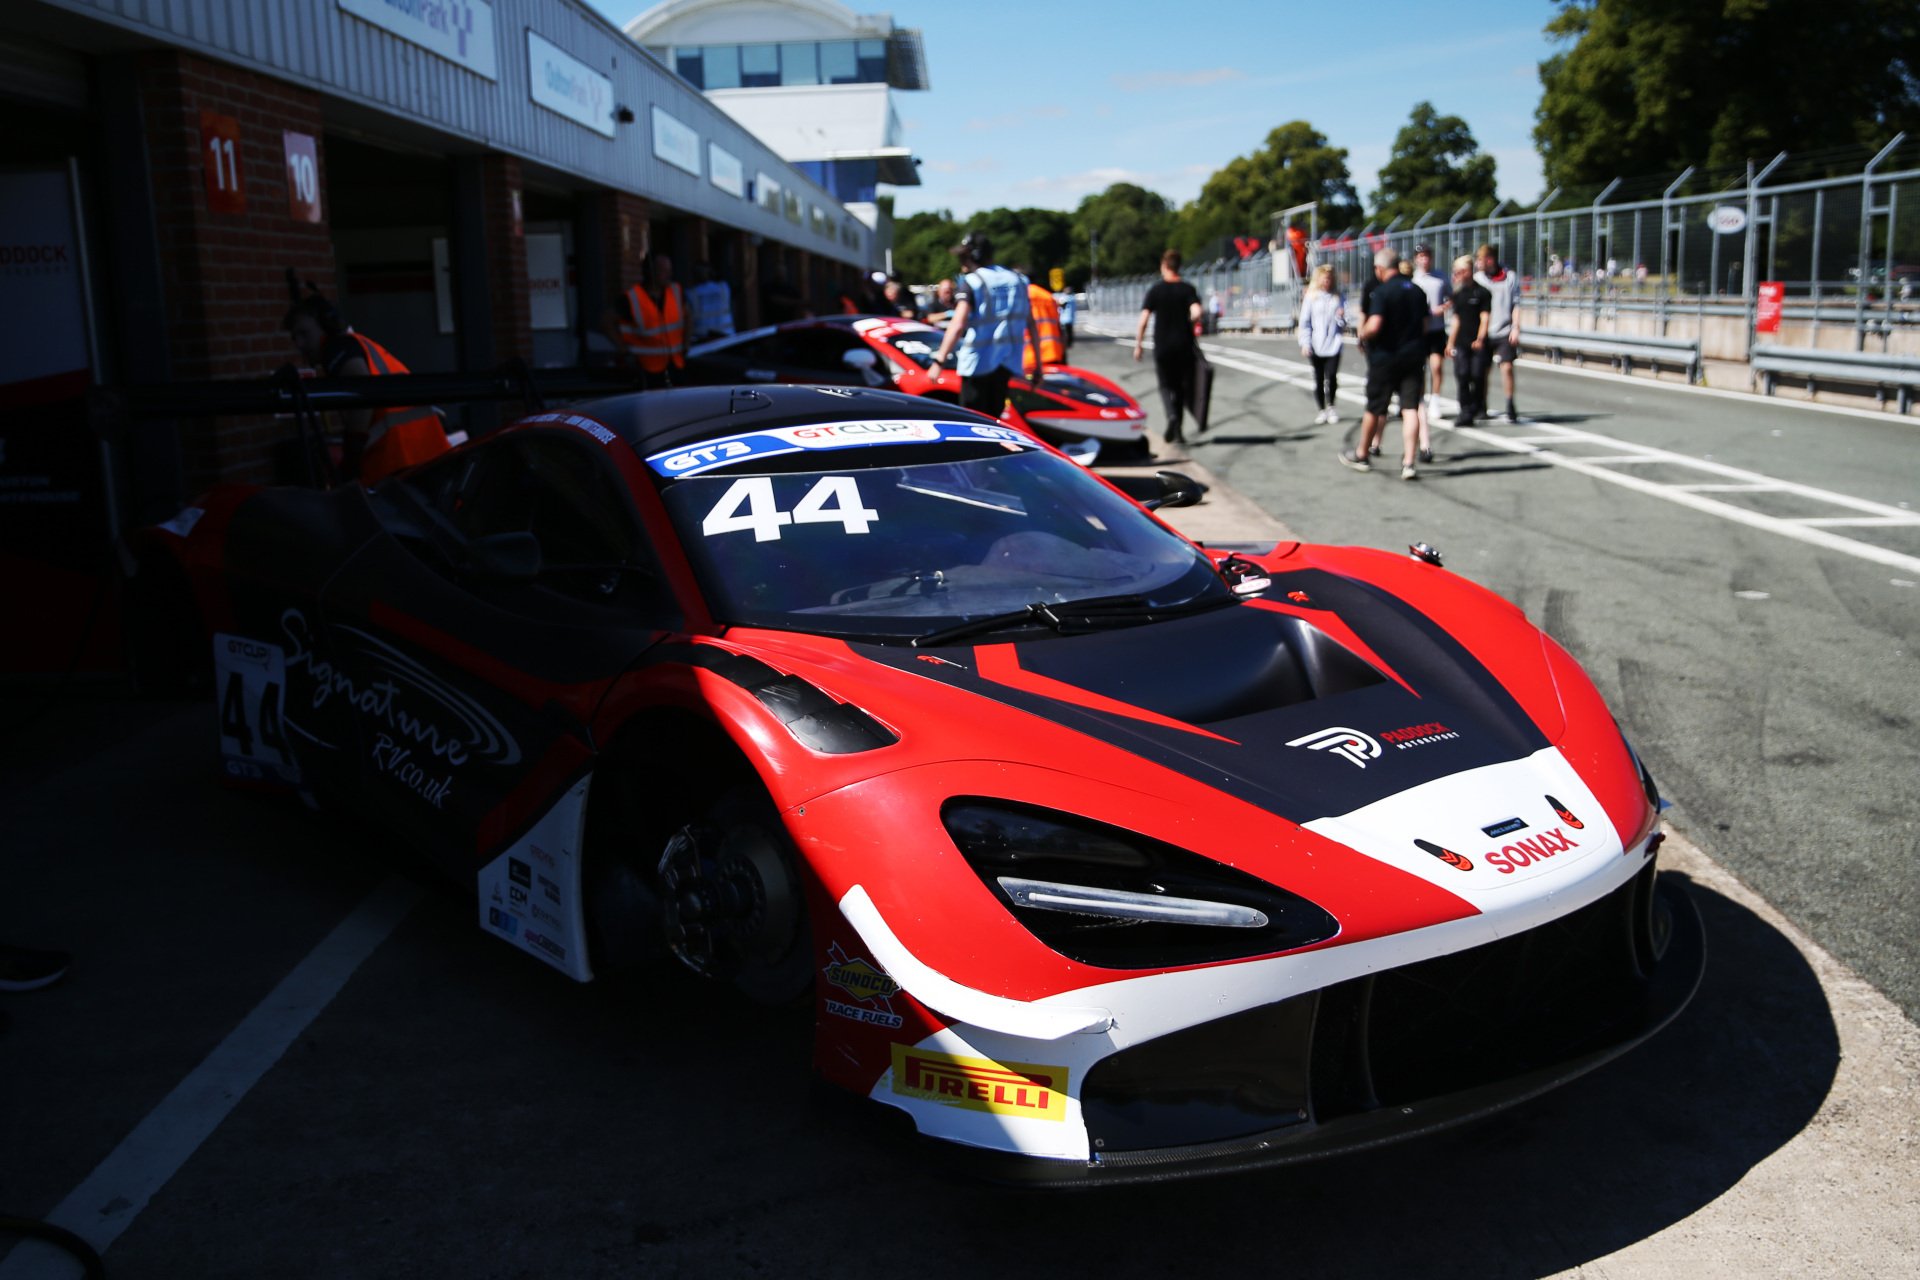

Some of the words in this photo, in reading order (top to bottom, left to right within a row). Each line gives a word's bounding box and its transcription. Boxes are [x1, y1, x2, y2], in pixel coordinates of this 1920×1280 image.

[209, 136, 238, 192] 11
[290, 153, 315, 204] 10
[664, 441, 752, 470] GT3
[702, 476, 879, 542] 44
[281, 607, 469, 767] Signature
[222, 672, 294, 767] 44
[1380, 721, 1452, 744] PADDOCK
[1396, 731, 1460, 750] MOTORSPORT
[1484, 828, 1580, 874] SONAX
[831, 968, 893, 994] SUNOCO
[828, 1002, 858, 1018] RACE
[862, 1011, 902, 1026] FUELS
[905, 1055, 1053, 1109] PIRELLI
